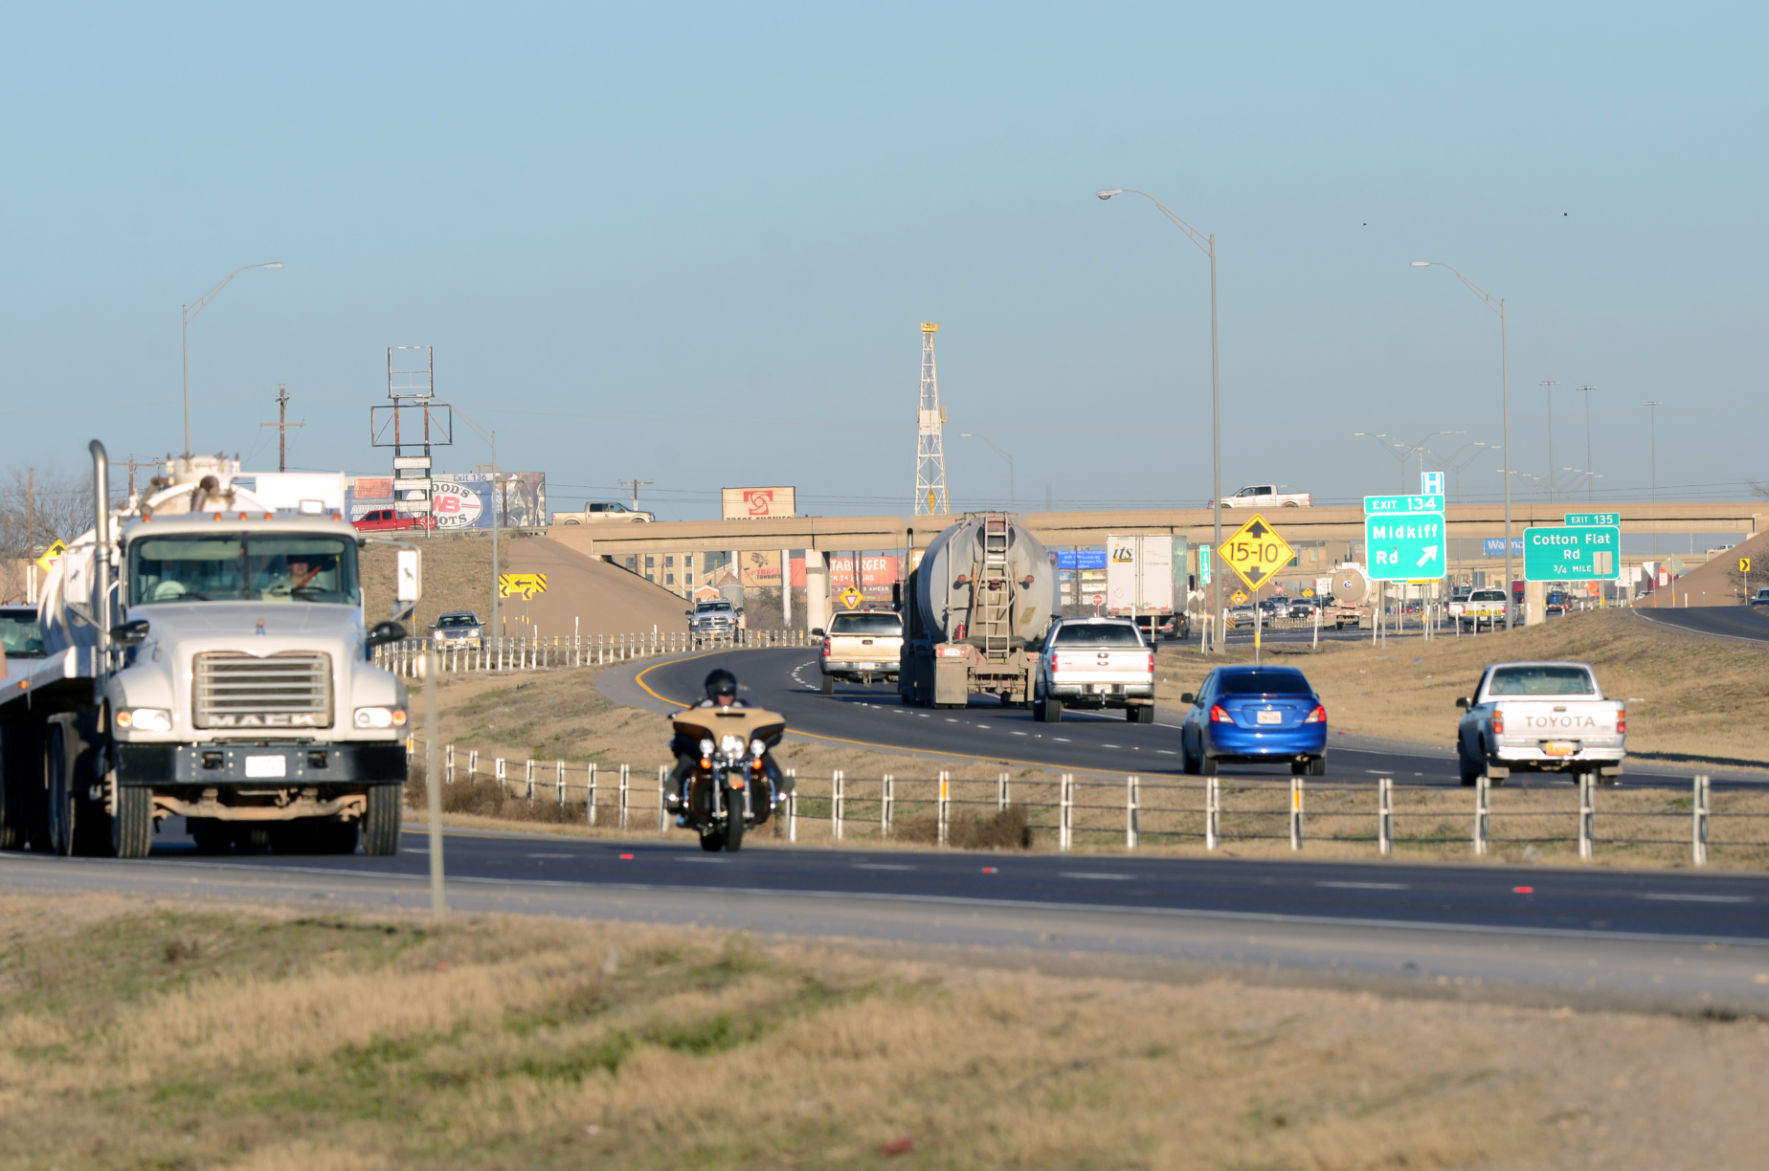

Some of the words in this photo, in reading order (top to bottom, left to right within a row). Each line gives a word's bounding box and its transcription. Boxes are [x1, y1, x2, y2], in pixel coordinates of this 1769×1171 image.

[453, 474, 469, 482] Exit
[1424, 472, 1441, 494] H
[1372, 500, 1397, 510] EXIT
[1407, 497, 1437, 510] 134
[1571, 516, 1589, 524] EXIT
[1594, 515, 1613, 525] 135
[1373, 523, 1438, 539] Midkiff
[1533, 534, 1578, 545] Cotton
[1585, 533, 1611, 544] Flat
[1376, 550, 1398, 564] Rd
[1563, 549, 1580, 560] Rd
[1553, 564, 1567, 574] 3/4
[1572, 565, 1592, 573] MILE
[208, 713, 316, 727] MACK
[1525, 716, 1596, 728] TOYOTA
